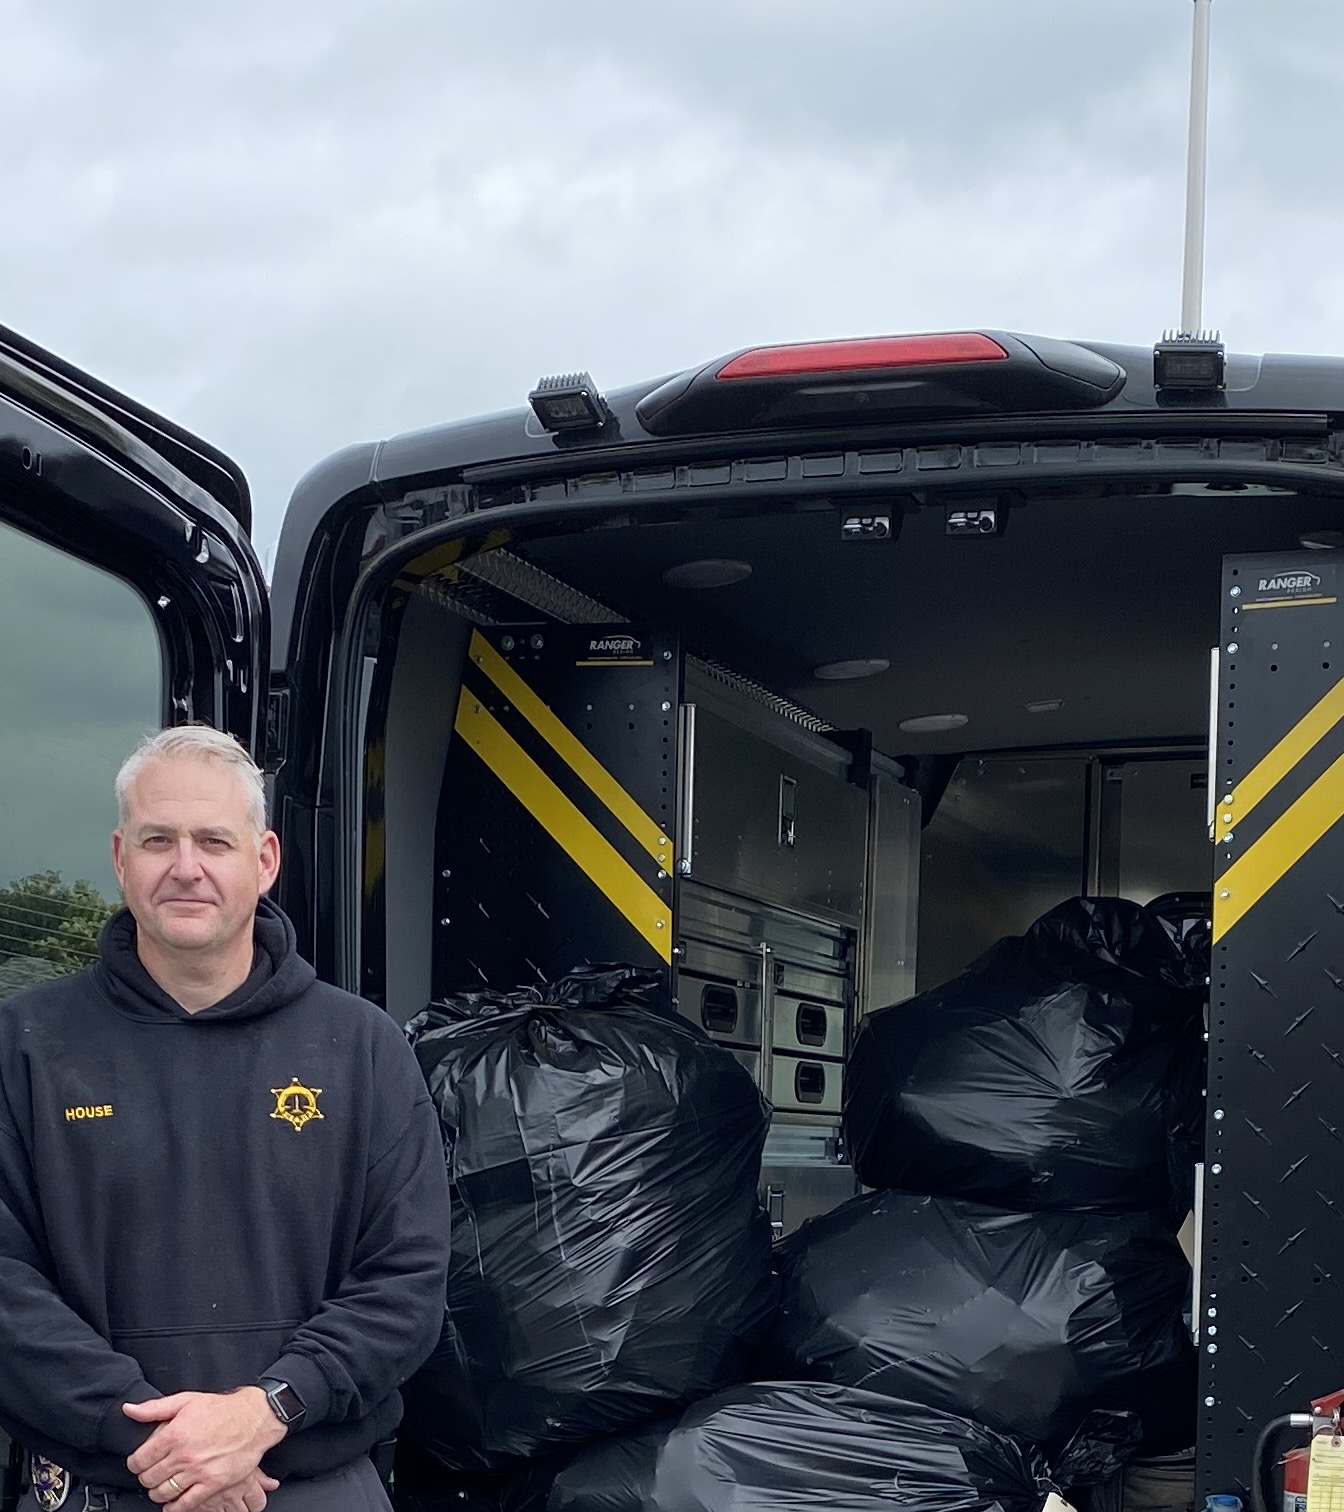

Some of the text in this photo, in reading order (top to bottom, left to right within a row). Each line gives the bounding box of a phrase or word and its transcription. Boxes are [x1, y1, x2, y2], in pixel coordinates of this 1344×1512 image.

[1258, 576, 1312, 591] RANGER
[589, 640, 634, 651] RANGER
[65, 1104, 114, 1121] HOUSE
